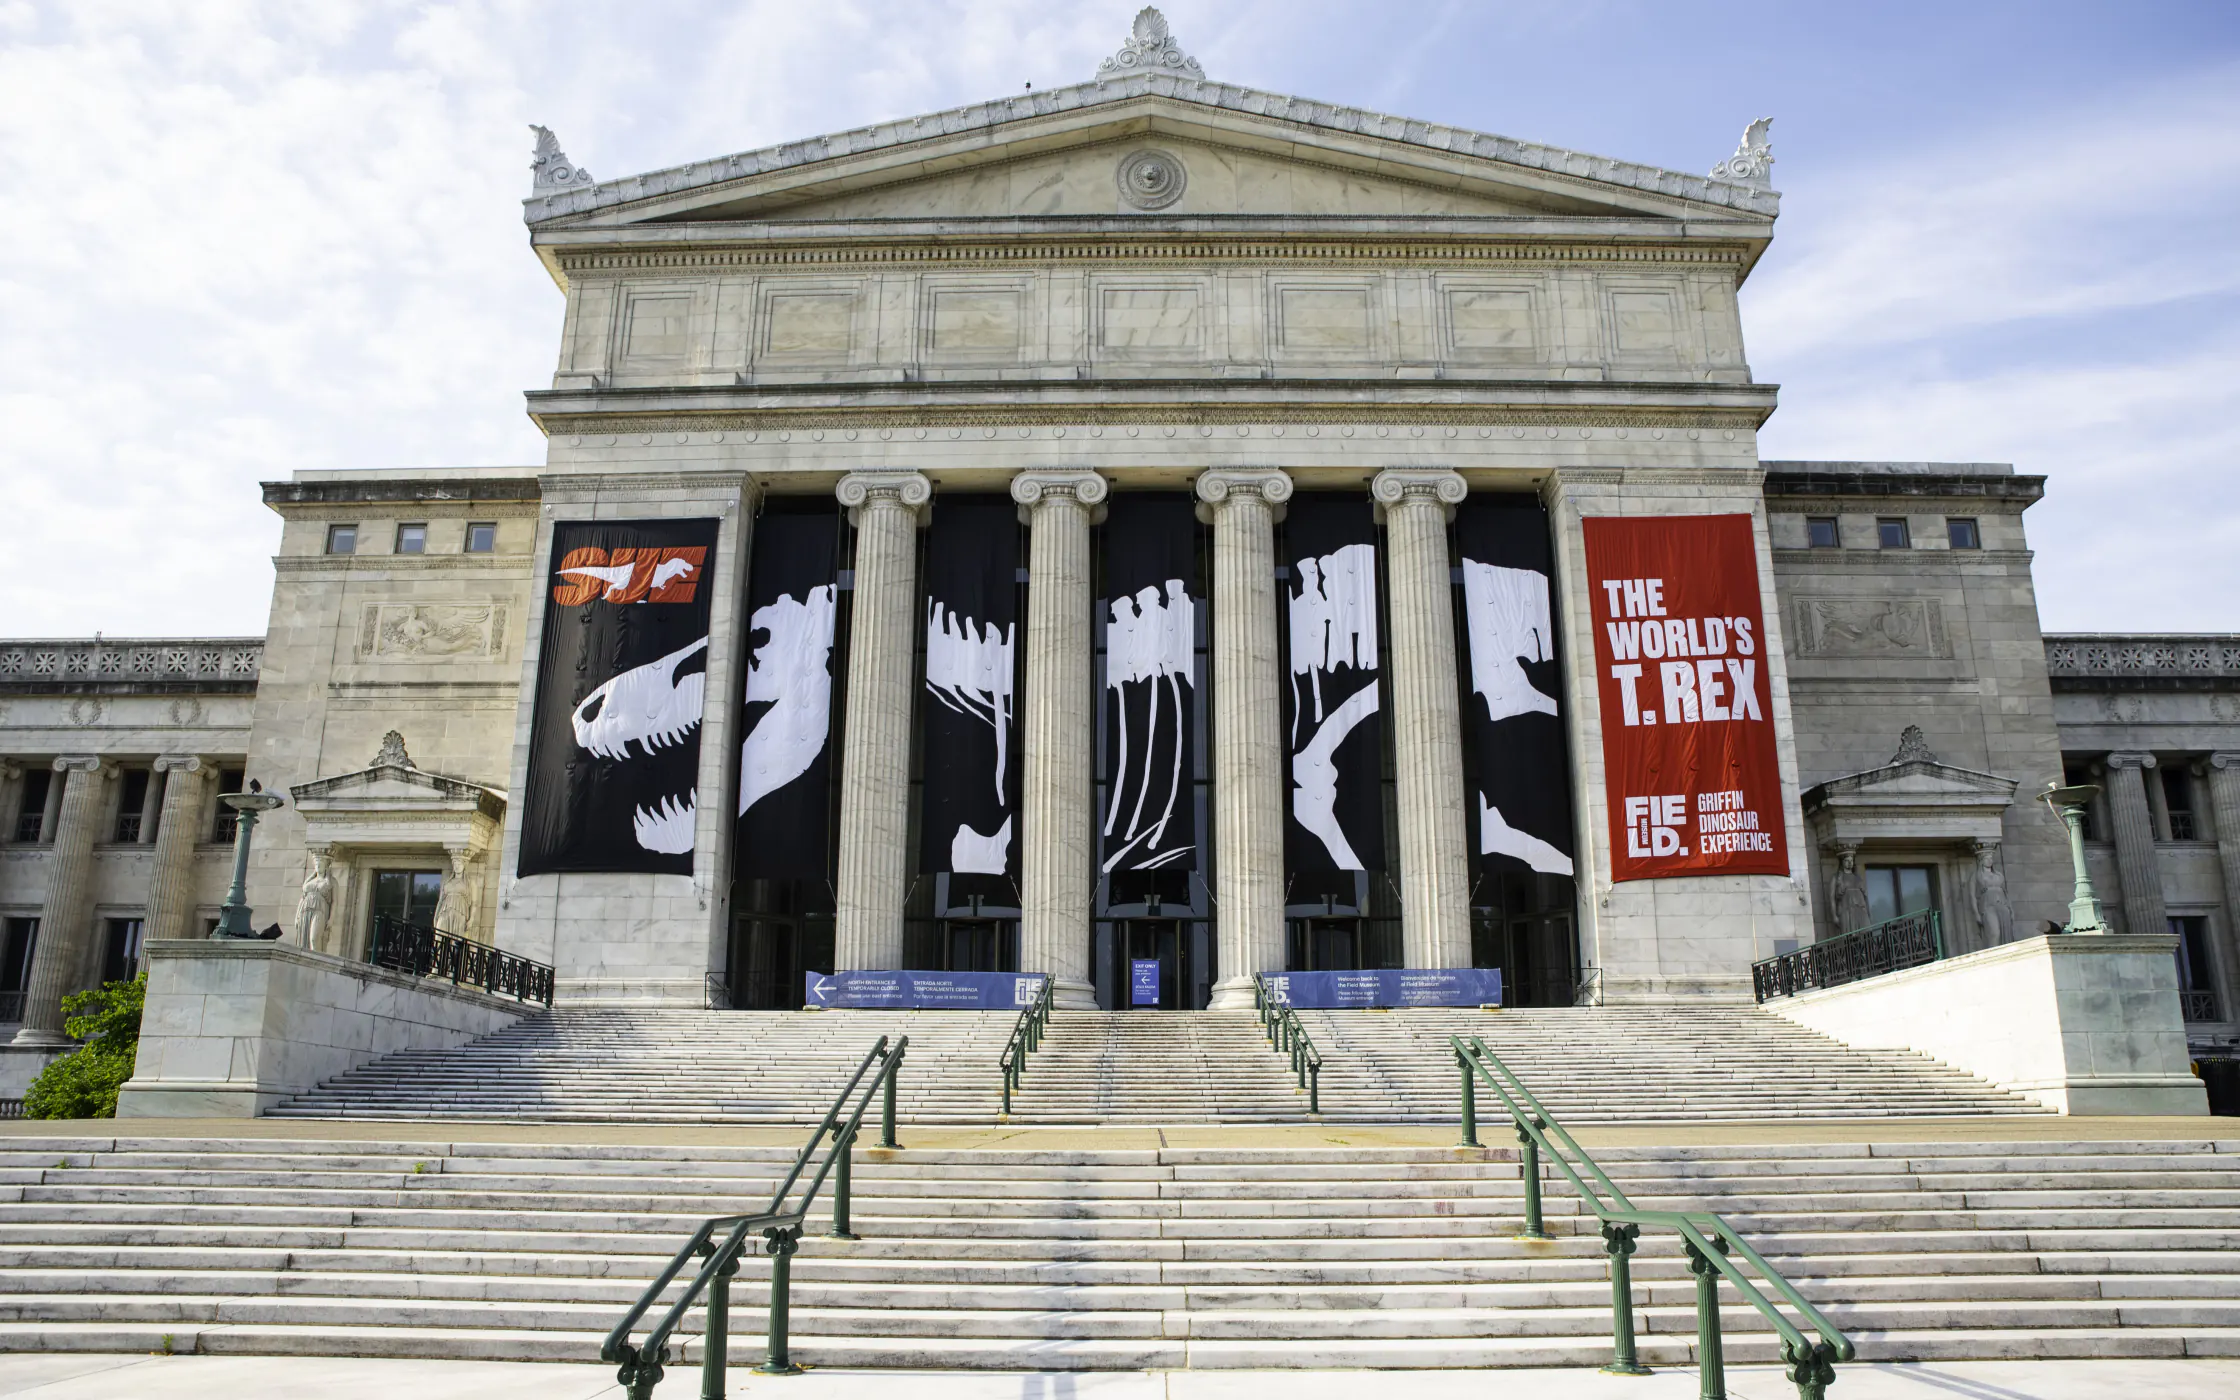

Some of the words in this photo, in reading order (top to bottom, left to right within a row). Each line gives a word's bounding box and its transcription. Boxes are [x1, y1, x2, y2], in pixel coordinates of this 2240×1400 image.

[553, 546, 708, 606] SUE
[1602, 578, 1667, 618] THE
[1606, 616, 1755, 660] WORLD'S
[1611, 663, 1657, 726] T.
[1659, 659, 1763, 724] REX
[1697, 790, 1745, 812] GRIFFIN
[1640, 818, 1649, 845] MUSEUM
[1698, 811, 1759, 833] DINOSAUR
[1700, 832, 1774, 854] EXPERIENCE
